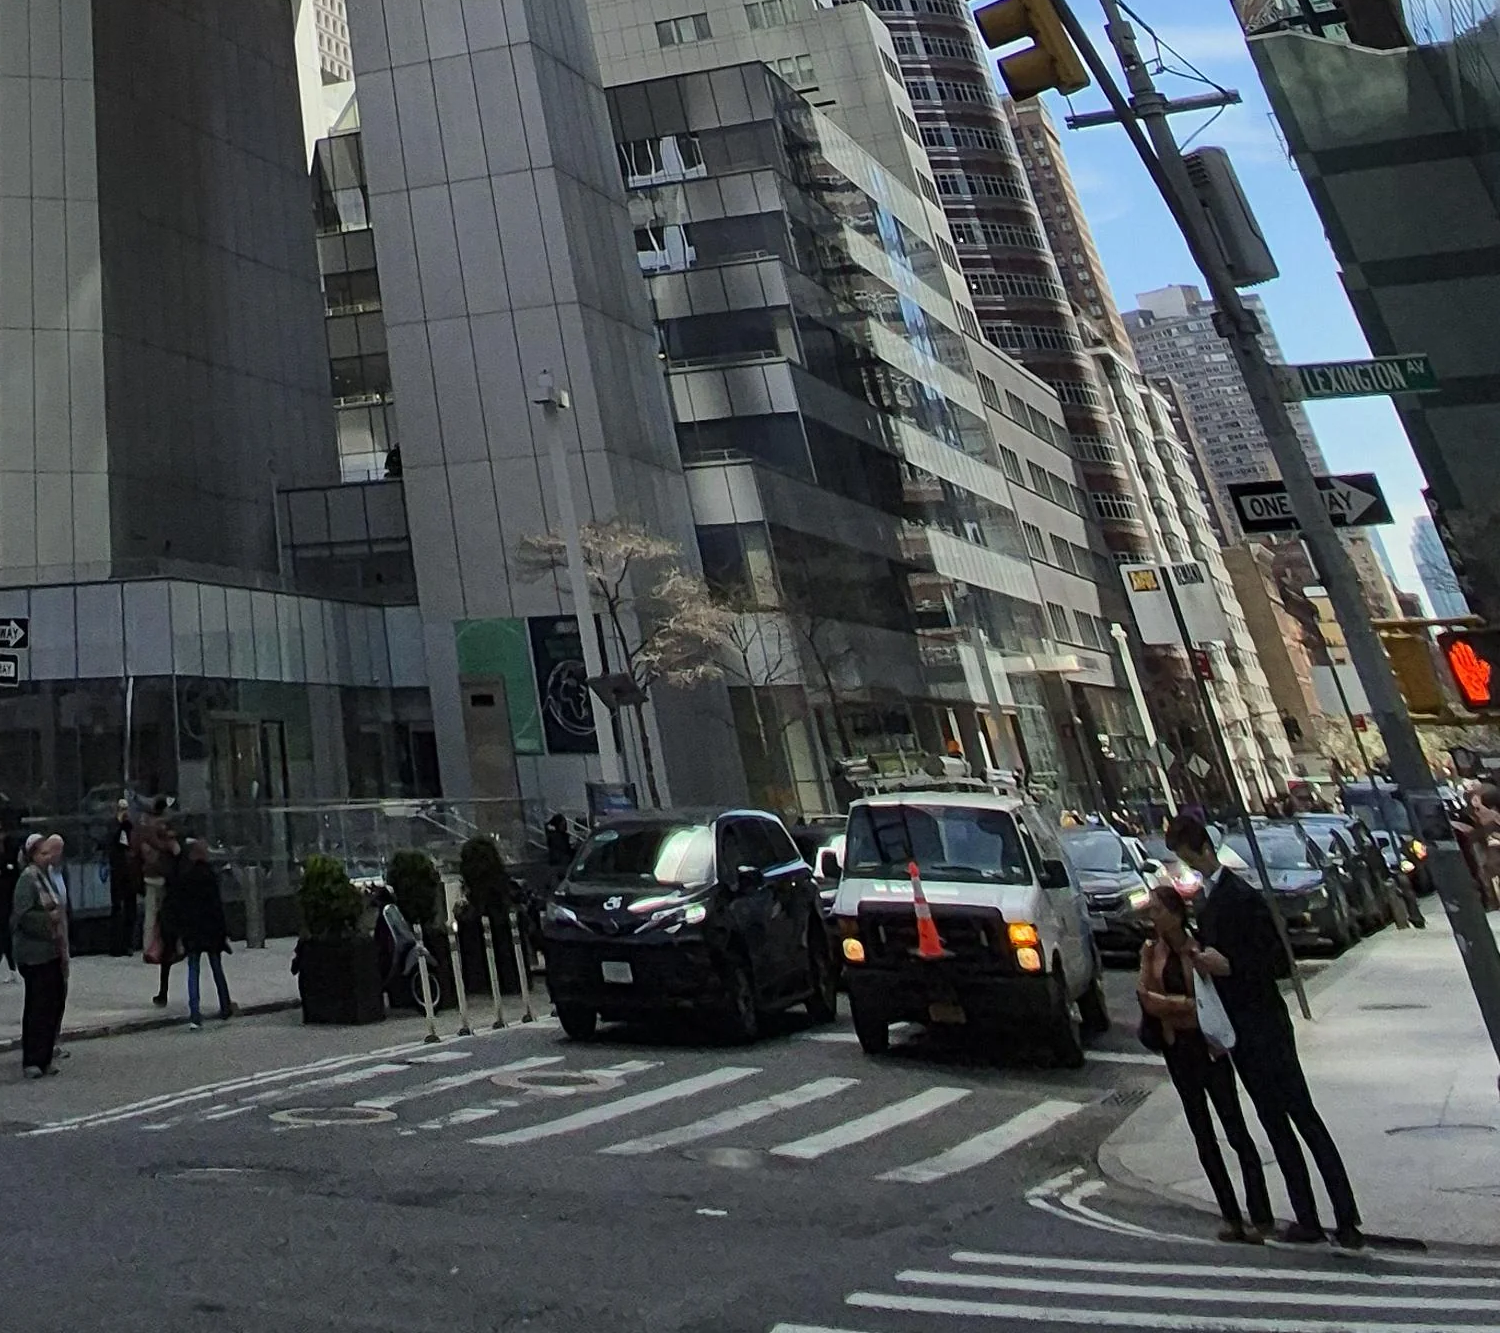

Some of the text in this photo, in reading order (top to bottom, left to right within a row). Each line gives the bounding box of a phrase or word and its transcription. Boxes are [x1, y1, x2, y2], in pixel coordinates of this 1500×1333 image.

[1302, 359, 1426, 394] LEXINGTON AV
[1250, 490, 1353, 518] ONE AY
[0, 627, 18, 639] WAY
